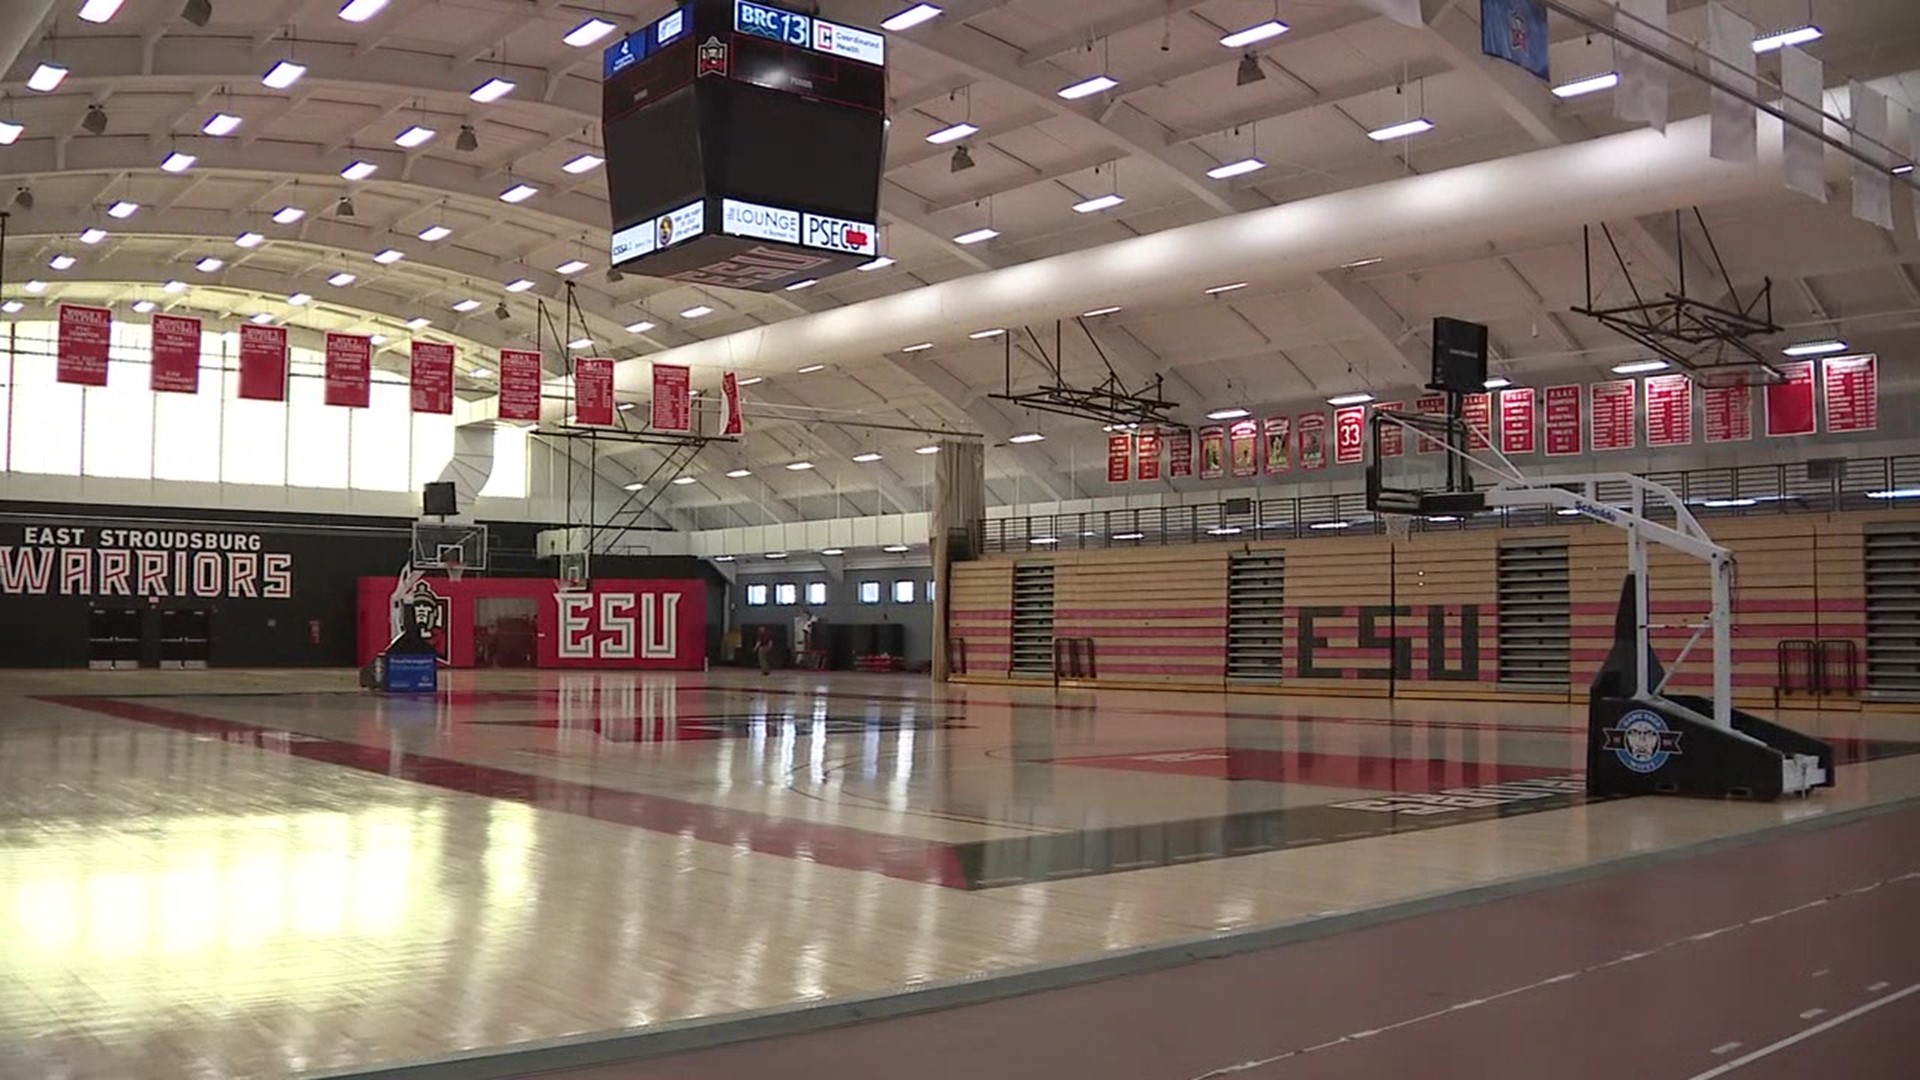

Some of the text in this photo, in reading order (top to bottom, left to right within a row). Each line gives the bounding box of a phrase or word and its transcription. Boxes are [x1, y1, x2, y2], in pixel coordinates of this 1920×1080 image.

[741, 4, 806, 44] BRC 13
[736, 208, 797, 230] LOUNGE
[1340, 424, 1360, 446] 33
[25, 527, 262, 551] EAST STROUDSBURG
[0, 546, 292, 598] WARRIORS
[555, 591, 682, 659] ESU
[1298, 604, 1479, 680] ESU
